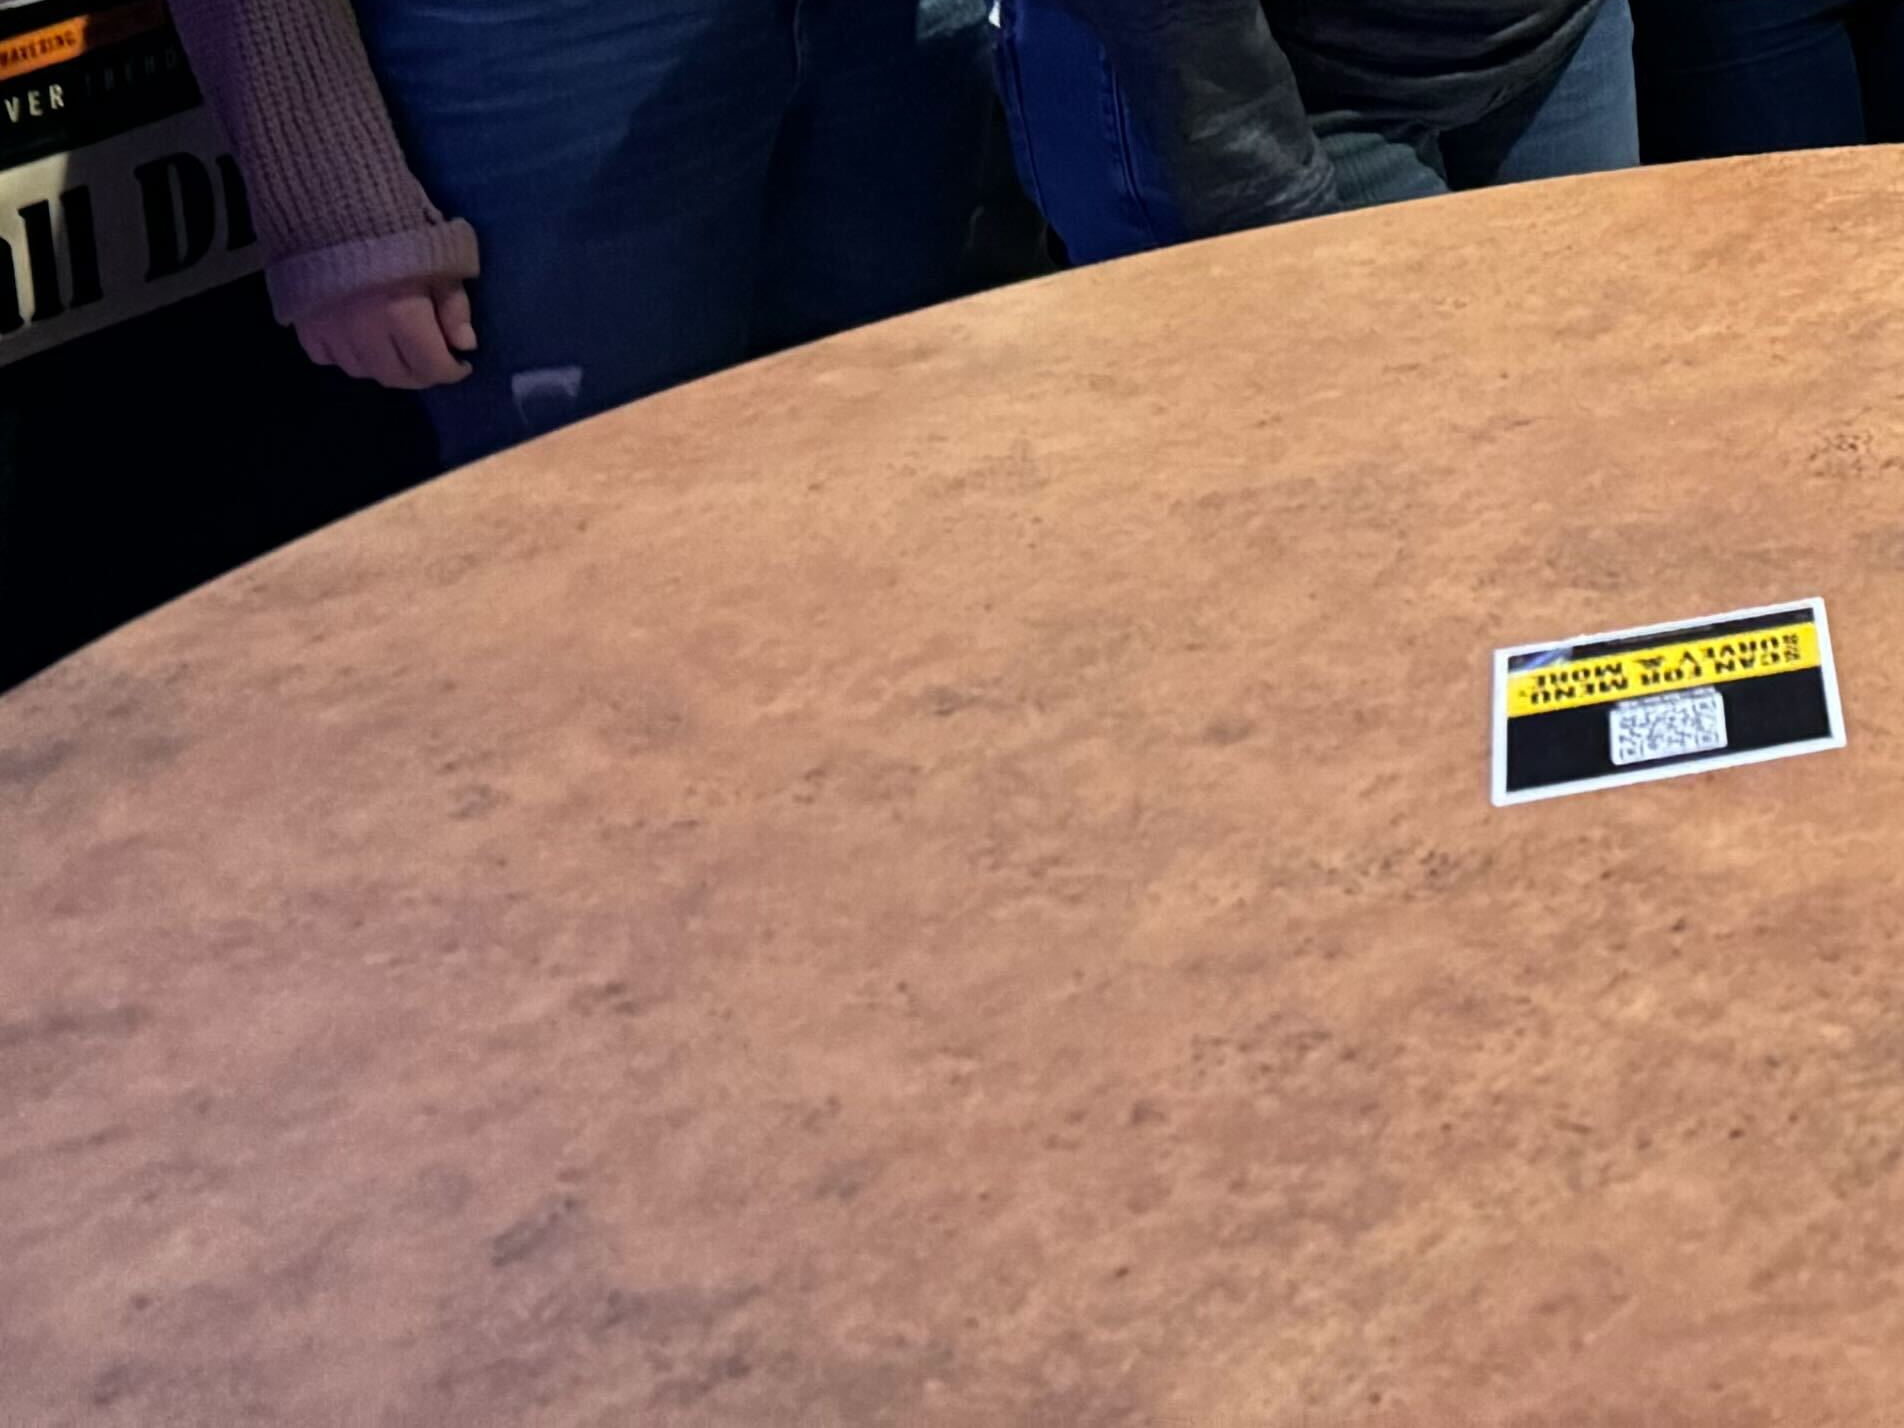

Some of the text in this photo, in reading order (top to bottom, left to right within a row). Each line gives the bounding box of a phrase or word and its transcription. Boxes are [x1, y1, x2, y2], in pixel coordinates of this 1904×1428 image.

[1532, 633, 1799, 689] SURVEY & MORE
[1714, 644, 1801, 675] SCAN
[1640, 664, 1702, 688] FOR
